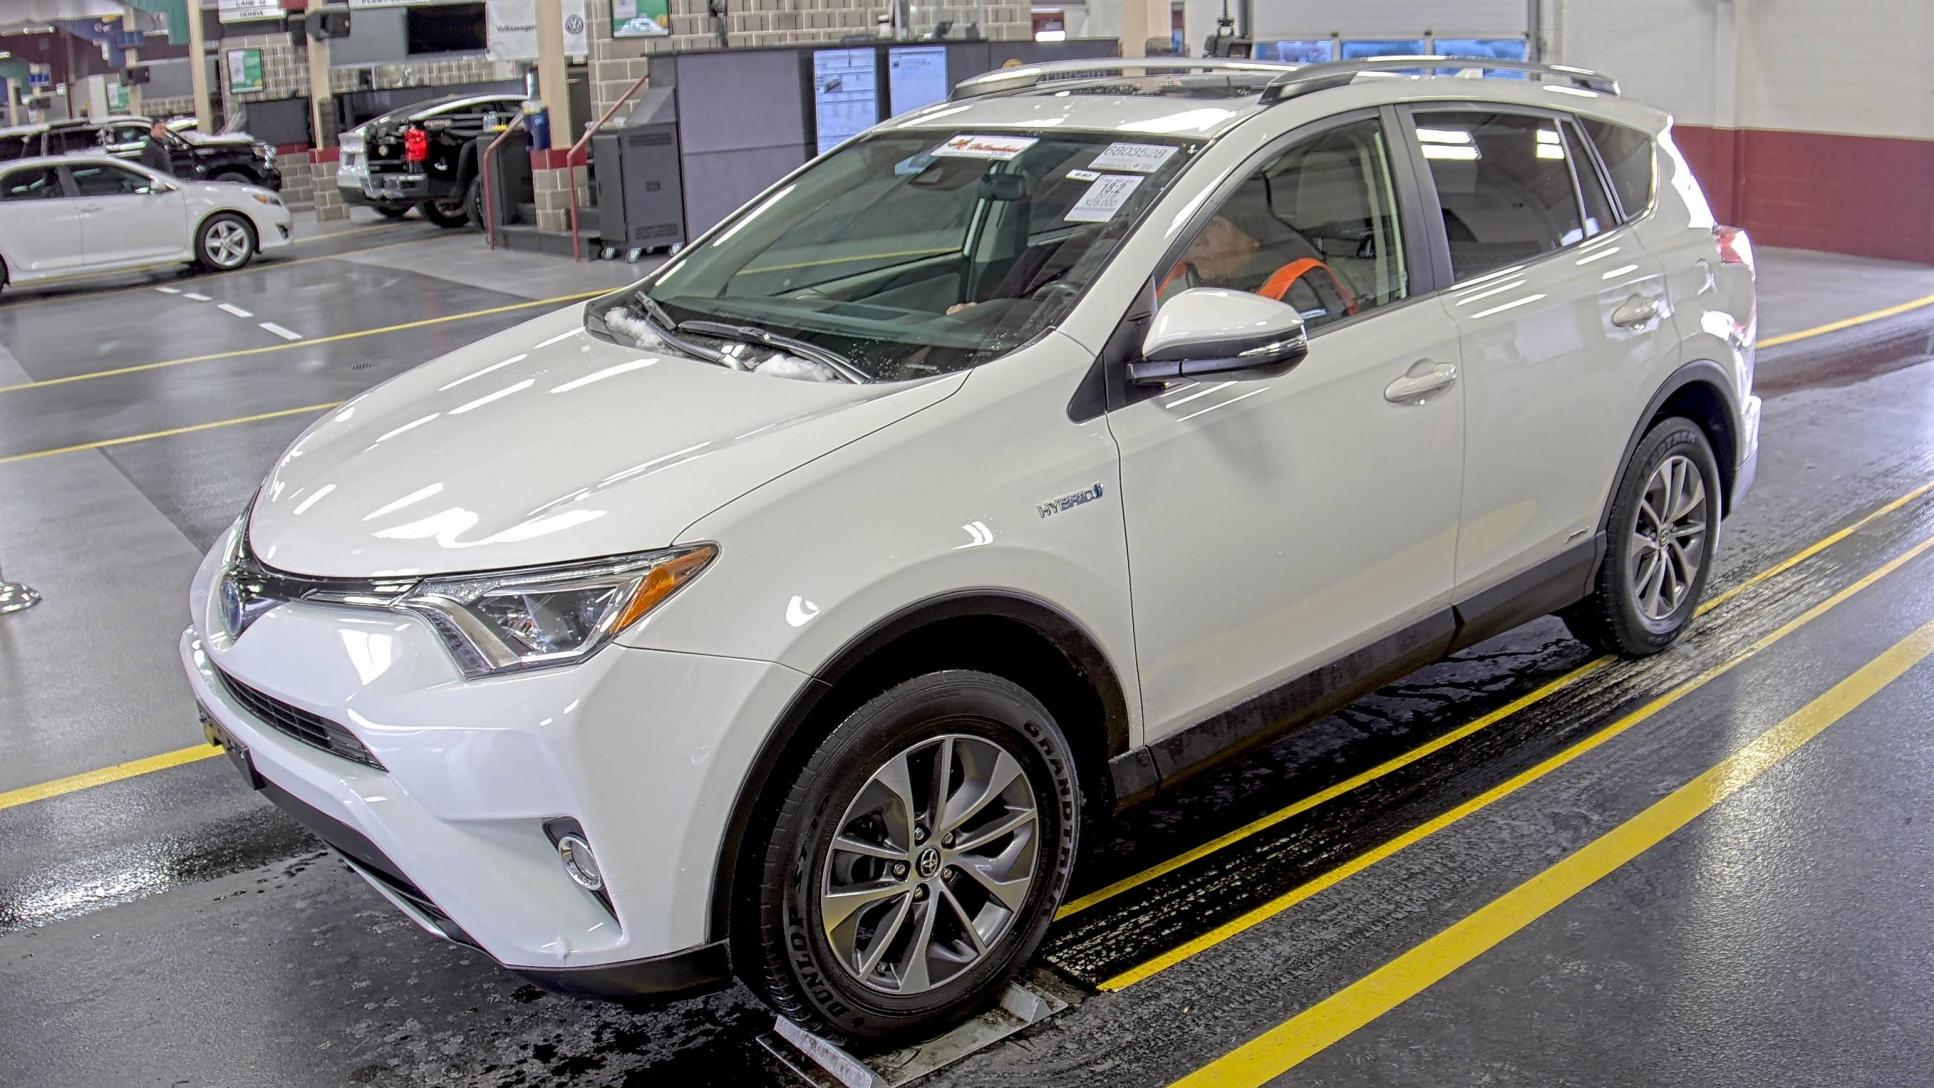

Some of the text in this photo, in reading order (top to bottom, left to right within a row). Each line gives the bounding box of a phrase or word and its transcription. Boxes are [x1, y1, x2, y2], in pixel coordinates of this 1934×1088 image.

[496, 24, 538, 33] Volkswagen
[1038, 486, 1095, 518] HYBRID
[788, 905, 850, 1018] DUNLOP
